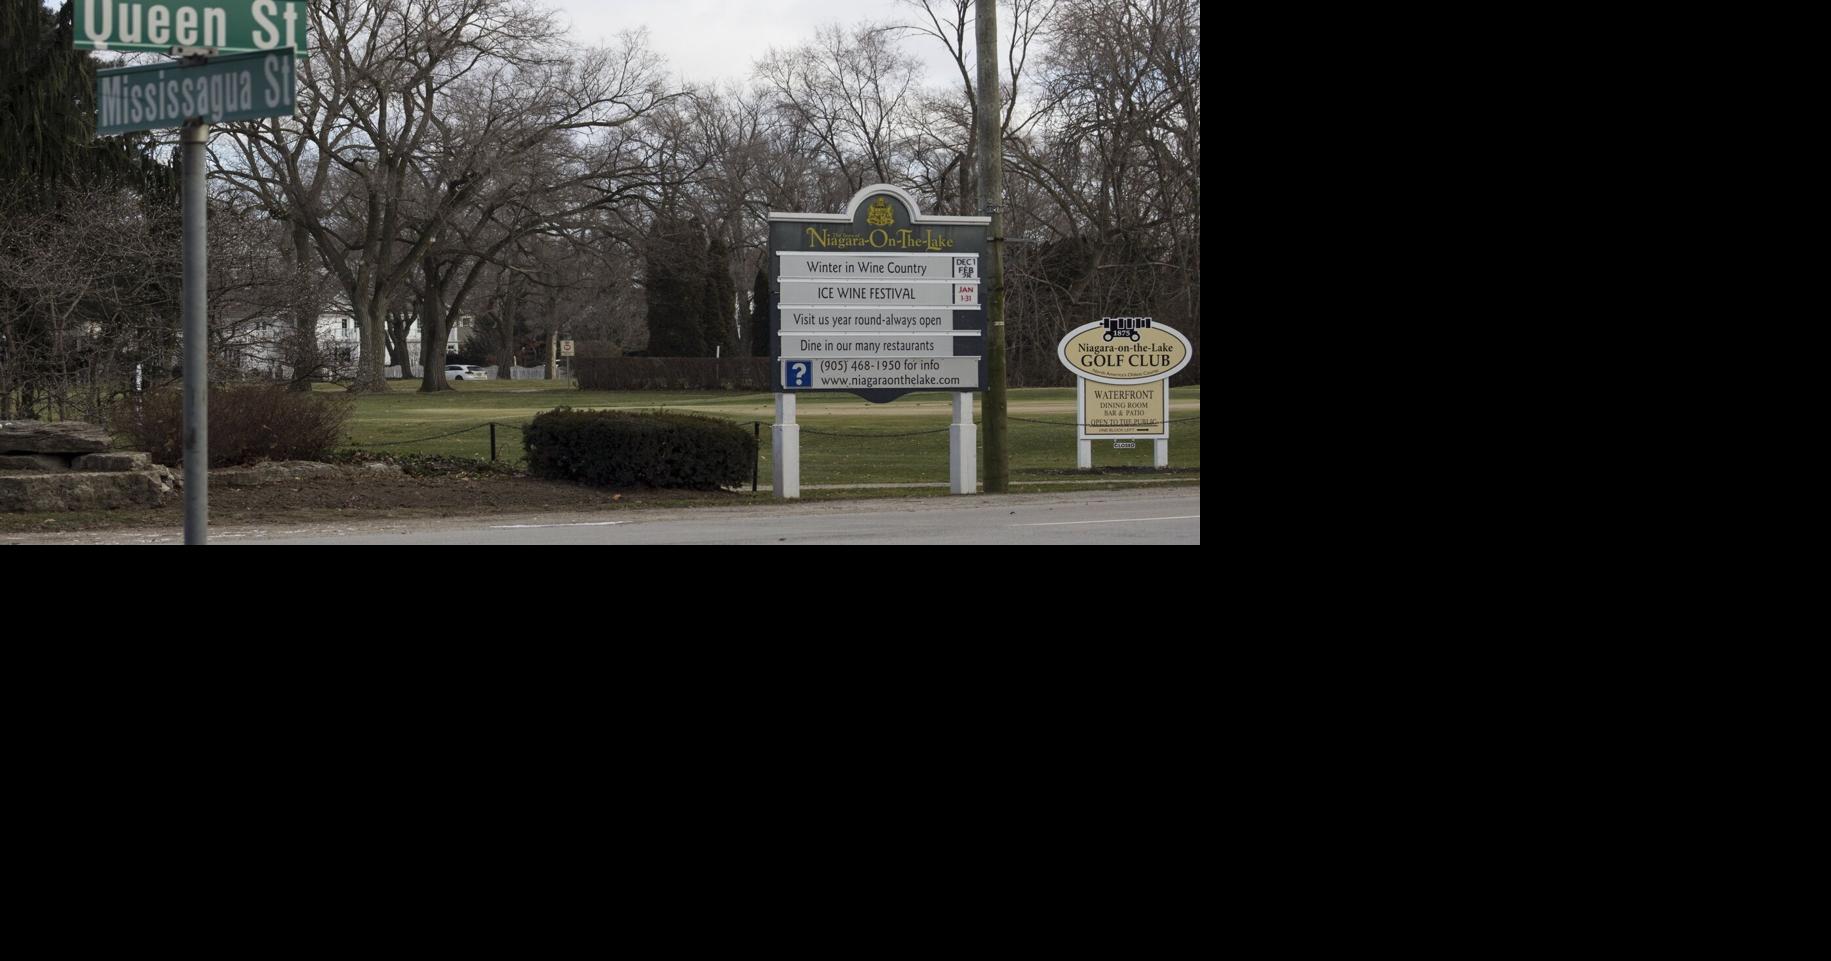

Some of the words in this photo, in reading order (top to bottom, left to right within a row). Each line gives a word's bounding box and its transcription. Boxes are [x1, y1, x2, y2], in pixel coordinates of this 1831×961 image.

[83, 0, 227, 49] Queen
[251, 0, 299, 49] St
[102, 70, 251, 127] Mississagua
[264, 53, 292, 108] St
[806, 226, 954, 251] Niagara-On-The-Lake
[807, 262, 842, 273] Winter
[846, 262, 855, 273] in
[857, 262, 885, 273] Wine
[887, 262, 927, 276] Country
[818, 288, 834, 299] ICE
[837, 288, 867, 299] WINE
[870, 288, 916, 299] FESTIVAL
[793, 314, 815, 325] Visit
[818, 316, 829, 325] us
[832, 316, 851, 328] year
[919, 316, 942, 328] open
[800, 340, 822, 351] Dine
[825, 340, 833, 351] in
[836, 342, 852, 351] our
[855, 342, 881, 354] many
[883, 340, 934, 351] restaurants
[1078, 343, 1174, 354] Niagara-on-the-Lake
[820, 360, 848, 373] (905)
[851, 360, 901, 371] 468-1950
[904, 359, 918, 371] for
[920, 359, 940, 371] info
[1081, 354, 1125, 367] GOLF
[1128, 354, 1170, 367] CLUB
[821, 375, 960, 388] www.niagaraonthelake.com
[1094, 390, 1154, 399] WATERFRONT
